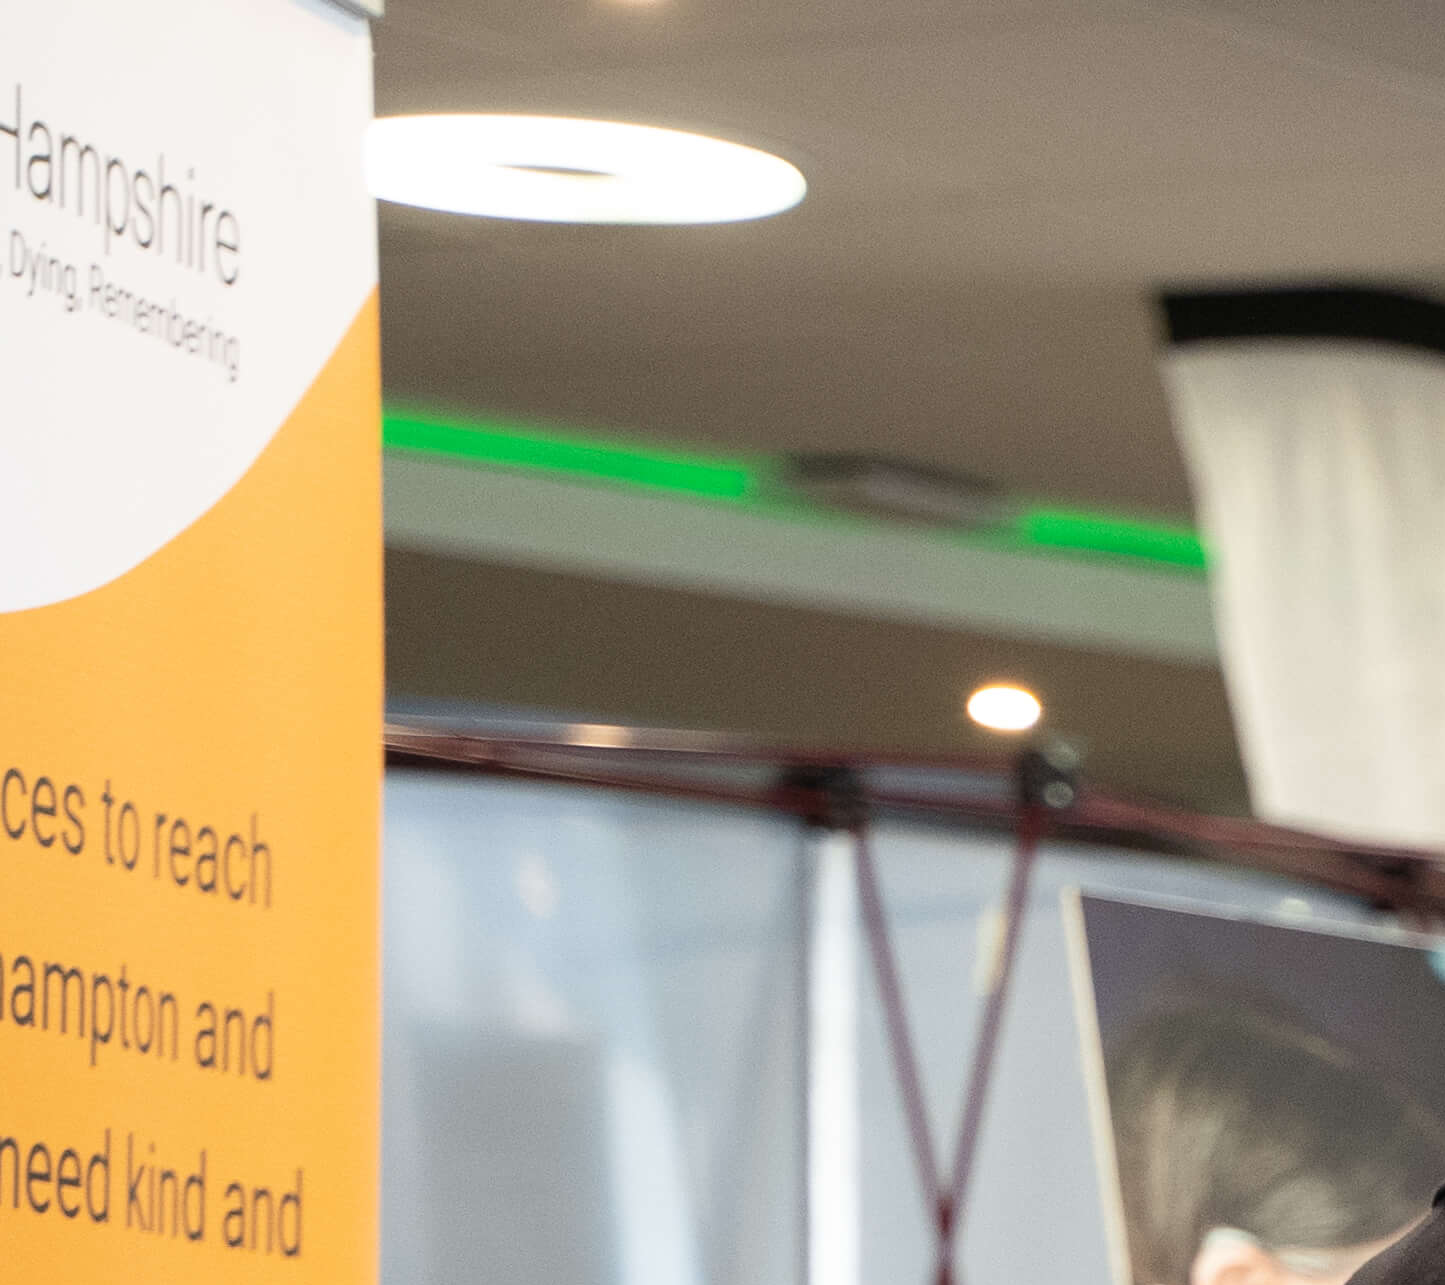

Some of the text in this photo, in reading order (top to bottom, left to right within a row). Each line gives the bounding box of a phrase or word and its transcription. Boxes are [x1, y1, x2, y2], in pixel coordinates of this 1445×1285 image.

[100, 779, 141, 871] to
[153, 812, 272, 908] reach
[0, 952, 274, 1081] ampton and
[0, 1128, 303, 1257] need kind and
